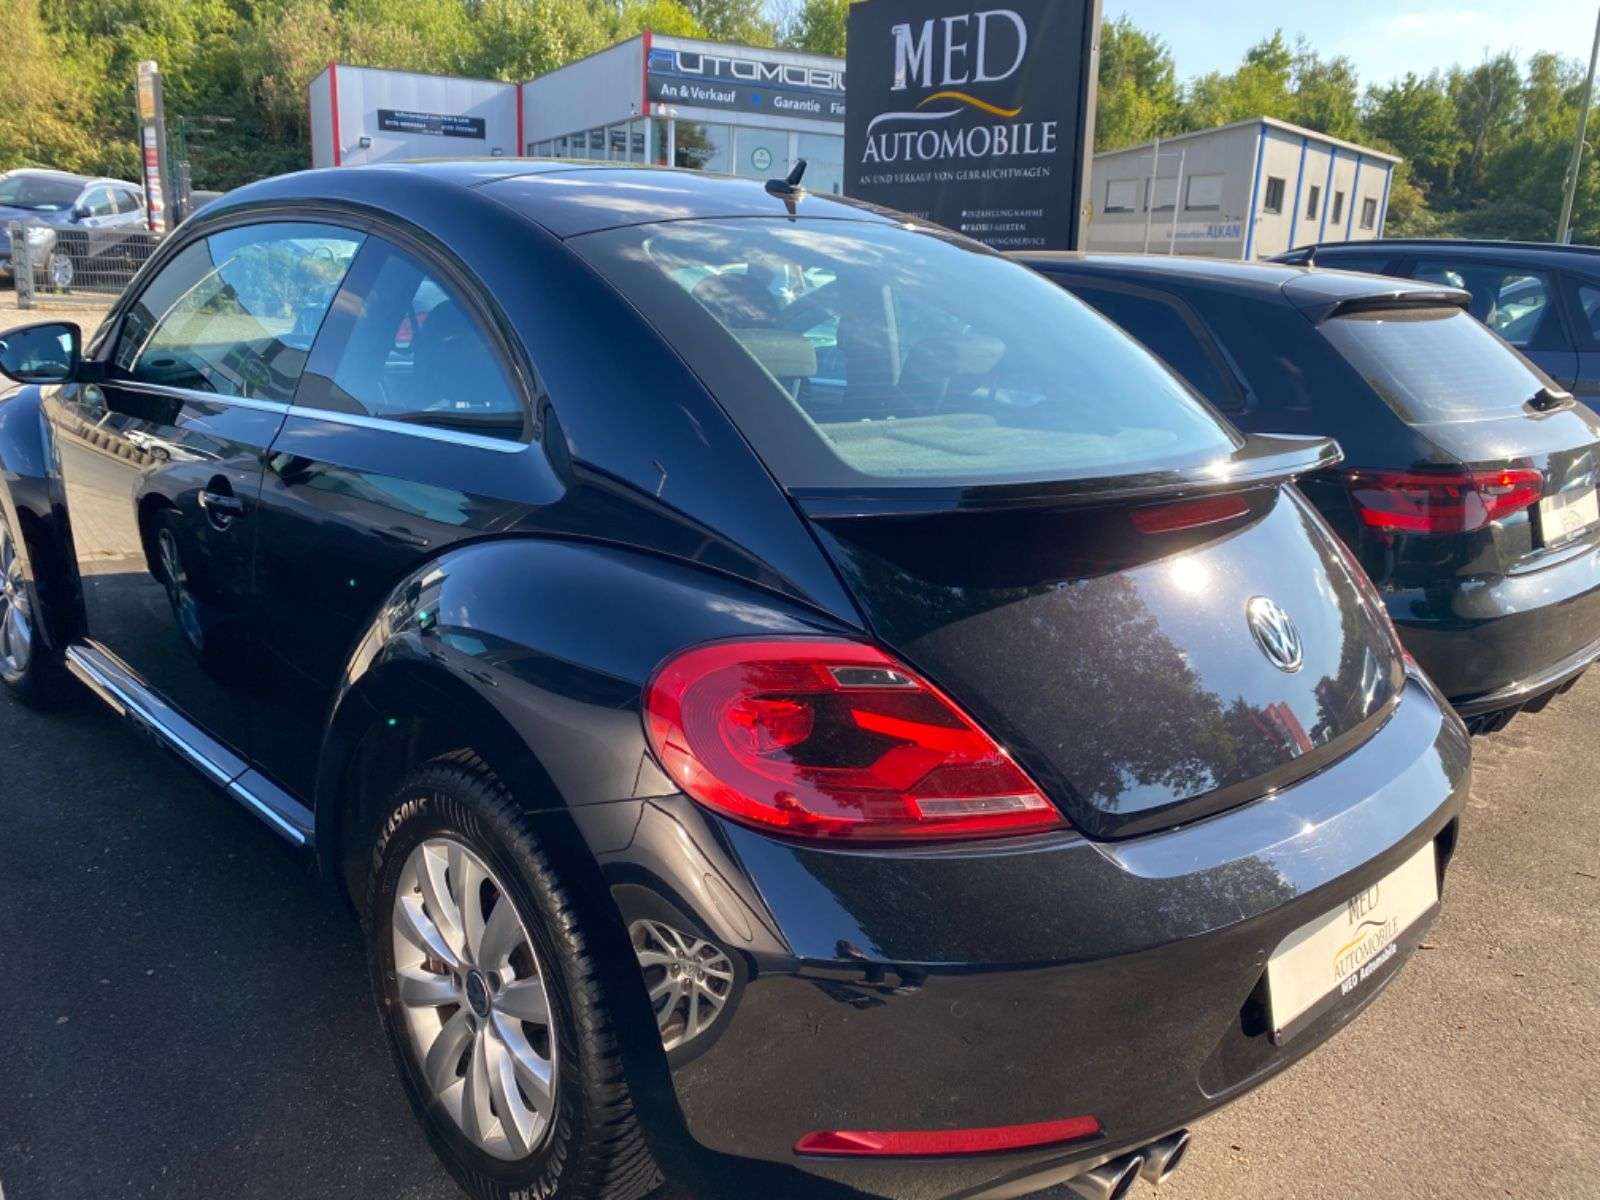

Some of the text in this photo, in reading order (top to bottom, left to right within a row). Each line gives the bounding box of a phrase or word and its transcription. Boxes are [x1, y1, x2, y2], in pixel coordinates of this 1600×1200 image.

[890, 9, 1028, 90] MED
[661, 84, 736, 103] An & Verkauf
[773, 96, 821, 113] Garantie
[861, 121, 1058, 163] AUTOMOBILE
[873, 173, 894, 184] UND
[894, 172, 932, 184] VERKAUF
[934, 170, 954, 182] VON
[956, 166, 1051, 181] GEBRAUCHTWAGEN
